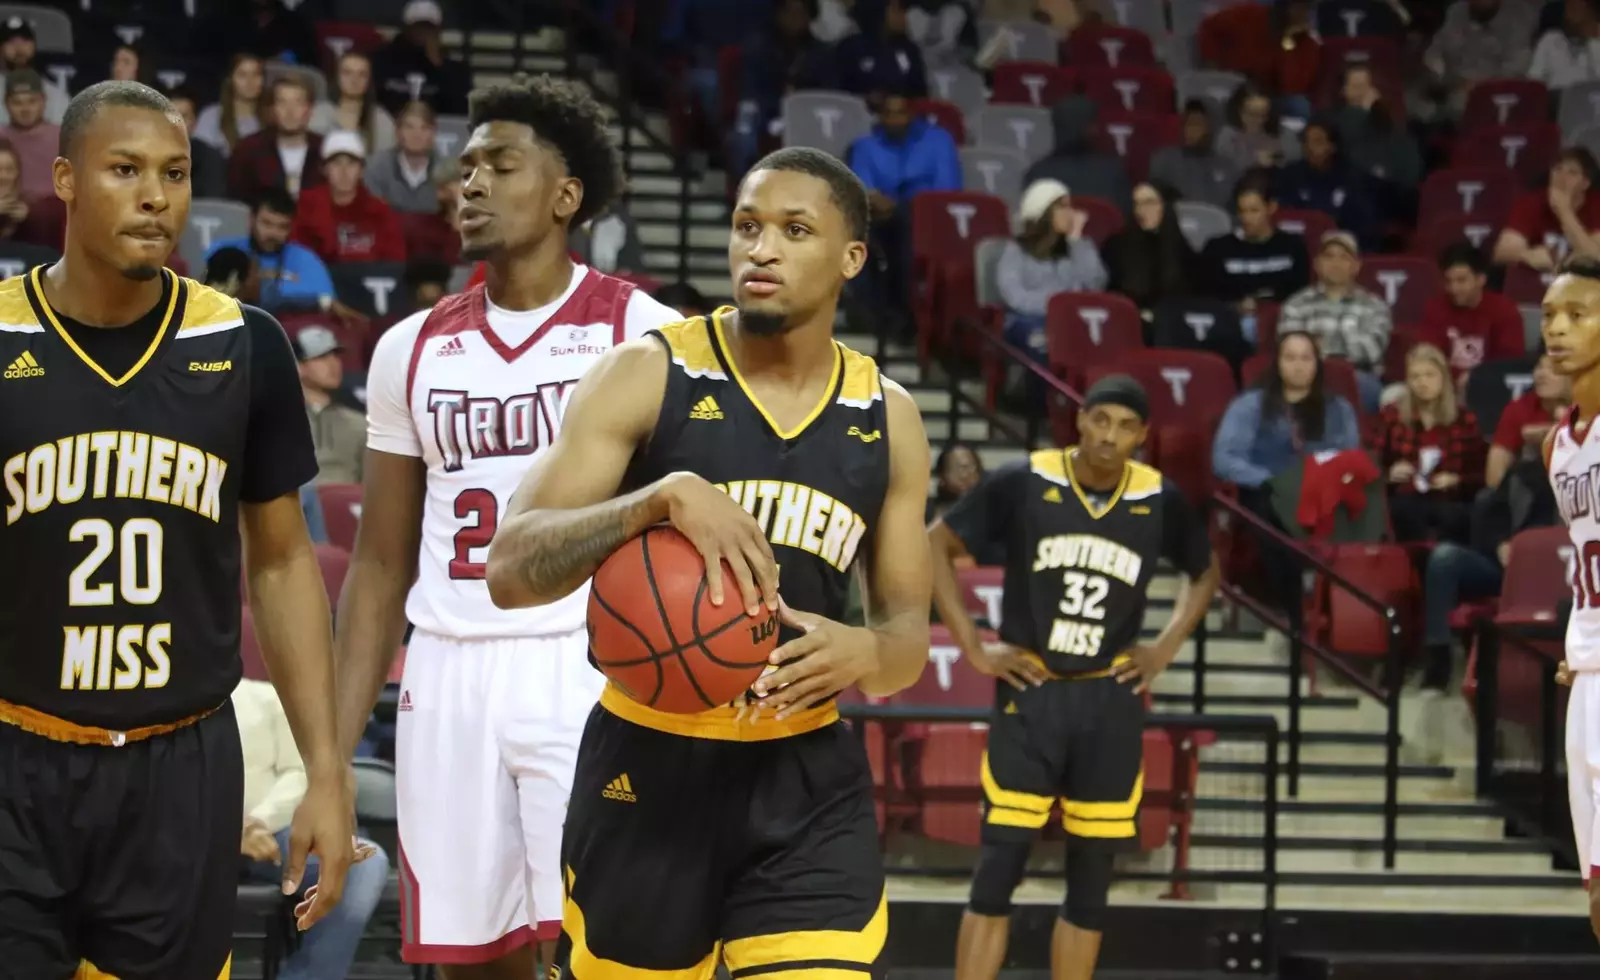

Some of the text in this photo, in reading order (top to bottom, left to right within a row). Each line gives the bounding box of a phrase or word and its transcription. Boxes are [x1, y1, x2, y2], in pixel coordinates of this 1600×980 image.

[1113, 80, 1140, 111] T
[815, 109, 843, 139] T
[1008, 118, 1035, 149] T
[1107, 125, 1133, 156] T
[976, 161, 1004, 192] T
[1457, 181, 1485, 213] T
[947, 203, 977, 238] T
[364, 277, 397, 315] T
[1377, 270, 1407, 306] T
[1078, 308, 1109, 345] T
[1184, 313, 1215, 341] T
[4, 367, 45, 379] adidas
[1161, 368, 1192, 405] T
[4, 431, 228, 526] SOUTHERN
[449, 488, 513, 580] 2
[712, 480, 867, 574] UTHERN
[68, 517, 164, 606] 20
[1032, 534, 1142, 587] SOUTHERN
[1059, 570, 1109, 620] 32
[1047, 618, 1105, 657] MISS
[60, 622, 171, 691] MISS
[929, 648, 961, 691] T
[602, 790, 637, 802] adidas
